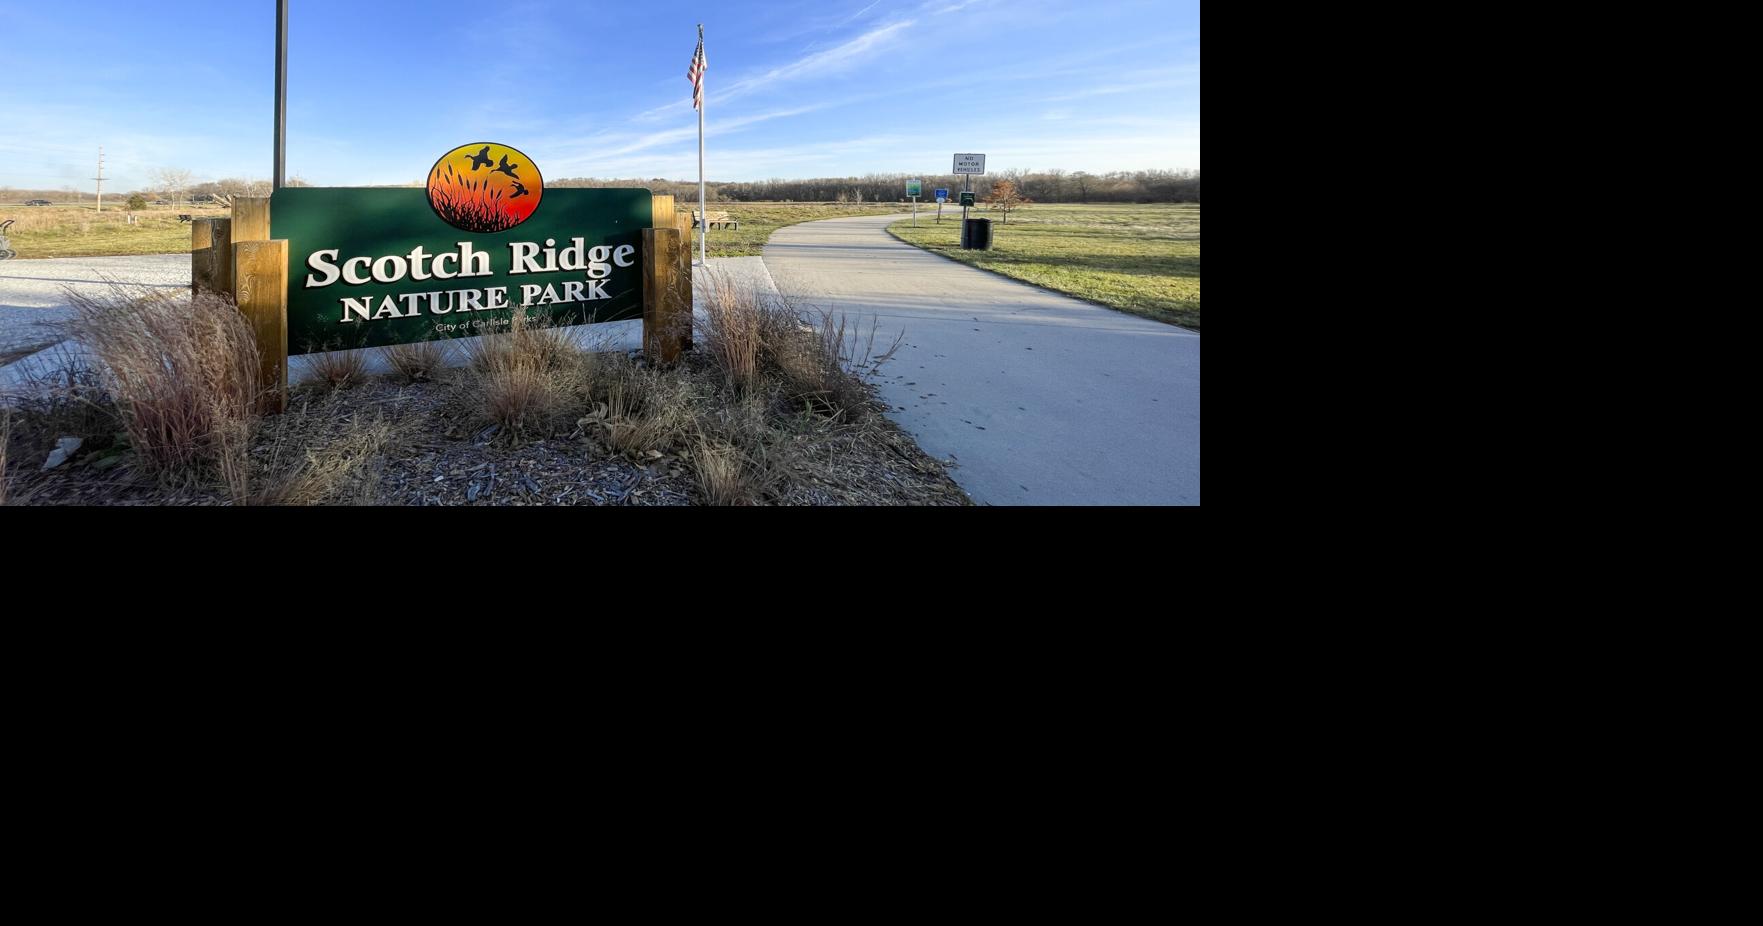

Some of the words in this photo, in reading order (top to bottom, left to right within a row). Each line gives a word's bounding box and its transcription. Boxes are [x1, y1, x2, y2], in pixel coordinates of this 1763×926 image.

[305, 241, 494, 288] Scotch
[508, 237, 635, 279] Ridge
[339, 286, 509, 323] NATURE
[519, 278, 613, 307] PARK
[435, 323, 457, 332] City
[459, 320, 470, 330] of
